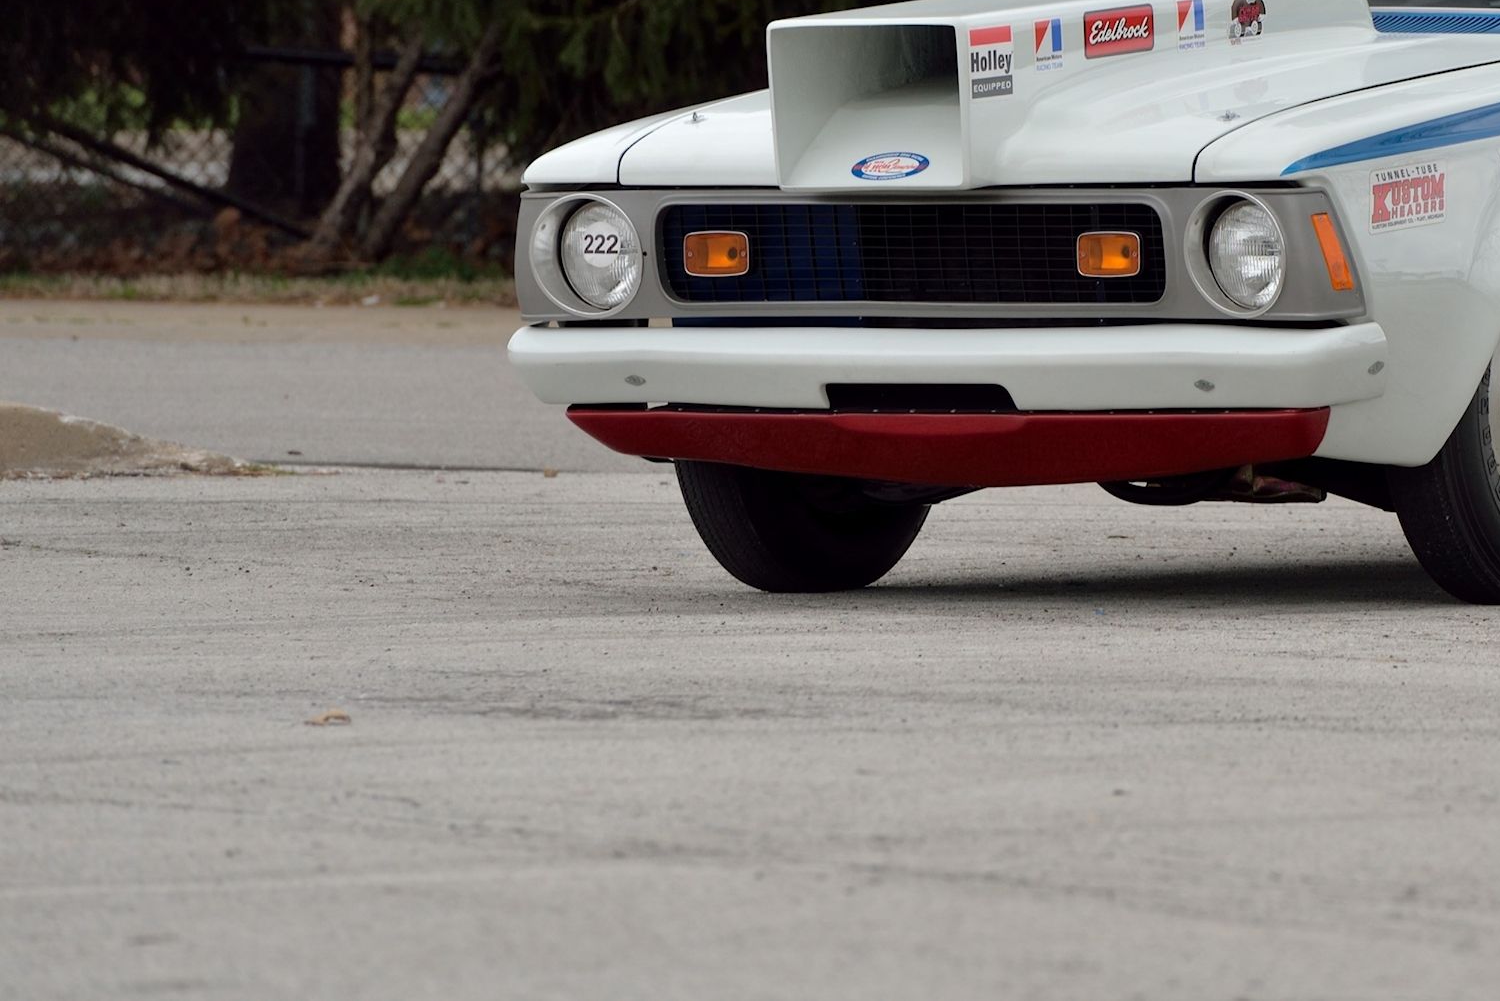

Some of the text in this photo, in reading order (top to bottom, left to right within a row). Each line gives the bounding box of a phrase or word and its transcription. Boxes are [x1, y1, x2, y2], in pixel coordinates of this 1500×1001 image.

[1089, 16, 1149, 46] Edelbrock
[970, 49, 1012, 75] Holley
[973, 80, 1012, 94] EQUIPPED
[1372, 173, 1445, 224] KUSTOM
[1391, 198, 1445, 219] HEADERS
[583, 233, 618, 254] 222
